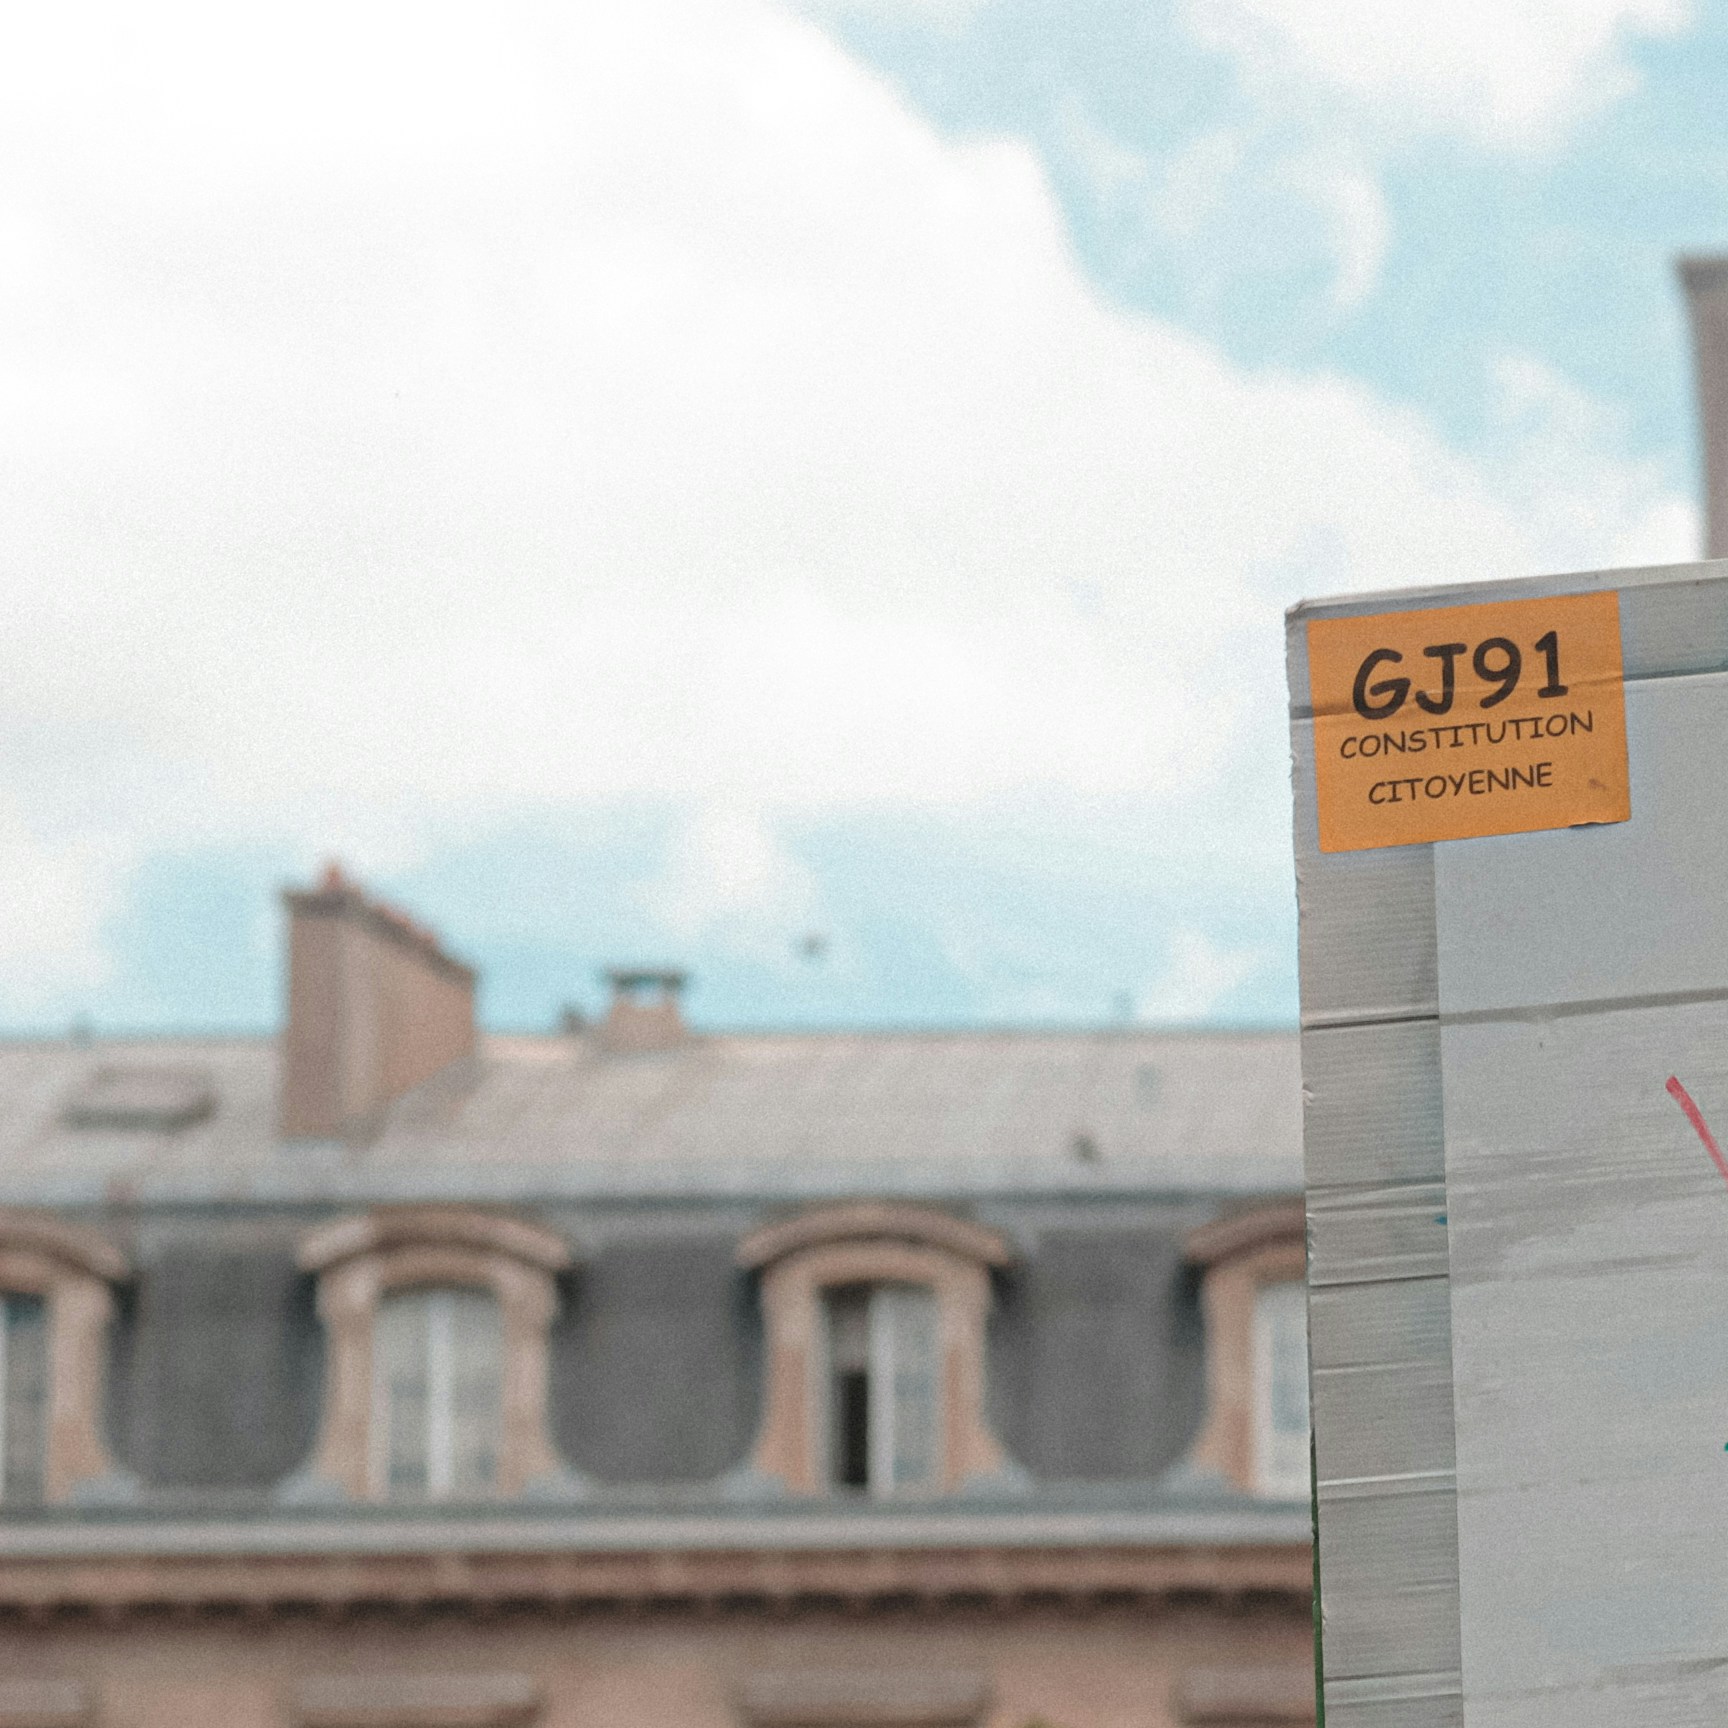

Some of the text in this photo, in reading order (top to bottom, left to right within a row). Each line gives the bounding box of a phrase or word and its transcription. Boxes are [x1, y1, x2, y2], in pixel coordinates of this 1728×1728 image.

[1352, 631, 1569, 720] GJ91
[1340, 710, 1594, 759] CONSTITUTION
[1368, 762, 1553, 805] CITOYENNE
